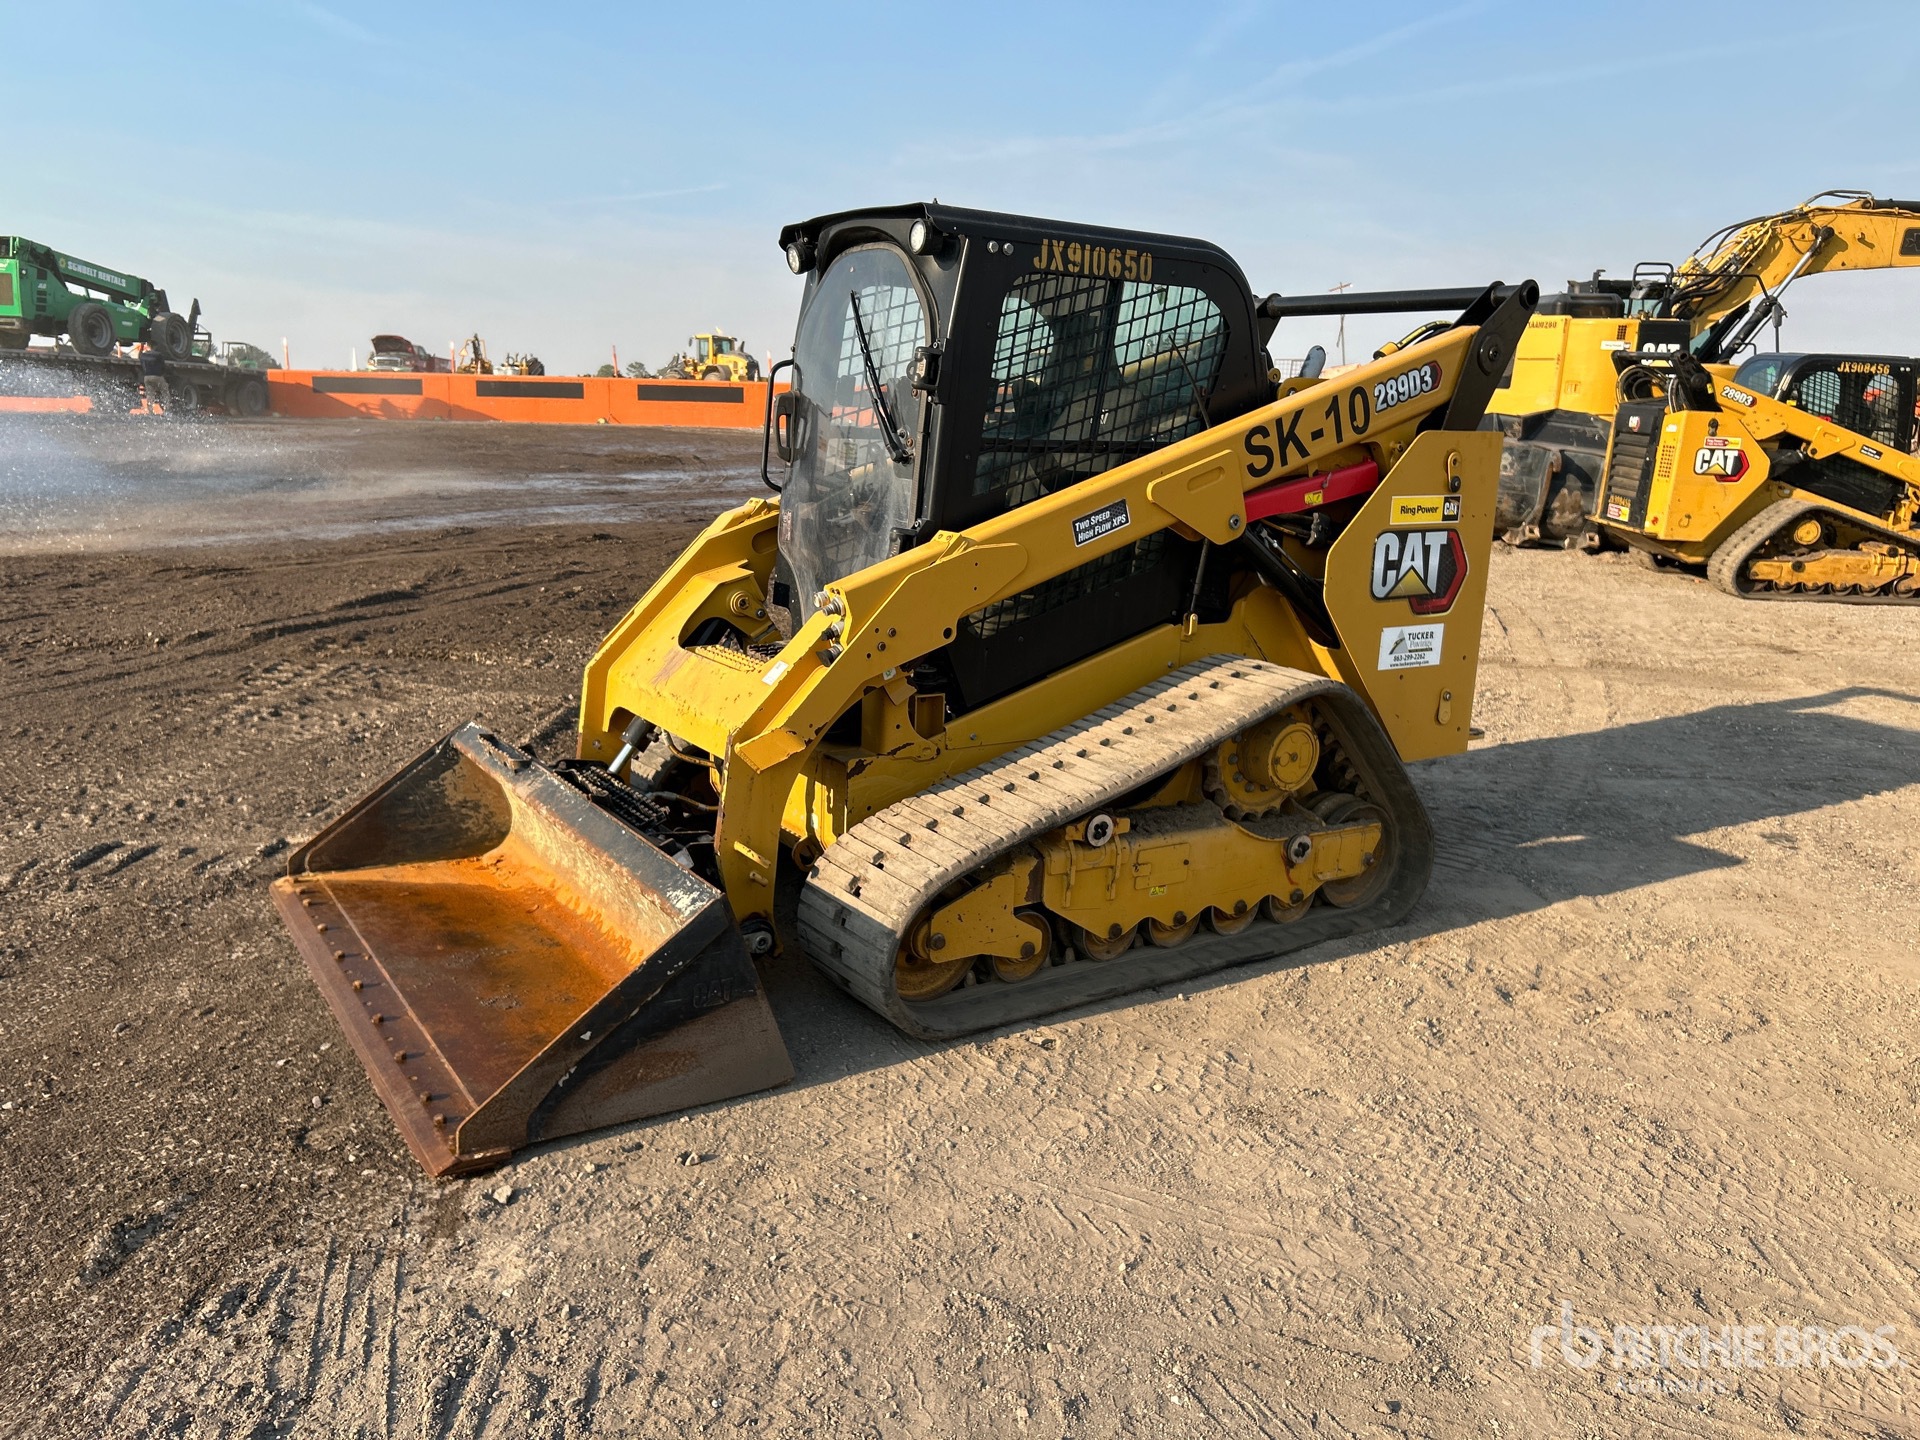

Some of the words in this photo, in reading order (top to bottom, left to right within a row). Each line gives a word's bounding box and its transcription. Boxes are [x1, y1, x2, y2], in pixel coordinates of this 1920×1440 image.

[1033, 238, 1153, 282] JX910650
[1837, 361, 1890, 375] JX908456
[1374, 364, 1434, 413] 289D3
[1720, 385, 1754, 407] 289D3
[1244, 386, 1371, 478] SK-10
[1694, 448, 1739, 476] CAT
[1400, 505, 1416, 516] Ring
[1416, 505, 1439, 514] Power
[1444, 502, 1458, 515] CAT
[1112, 513, 1127, 528] XPS
[1372, 530, 1448, 599] CAT
[1408, 631, 1434, 641] TUCKER
